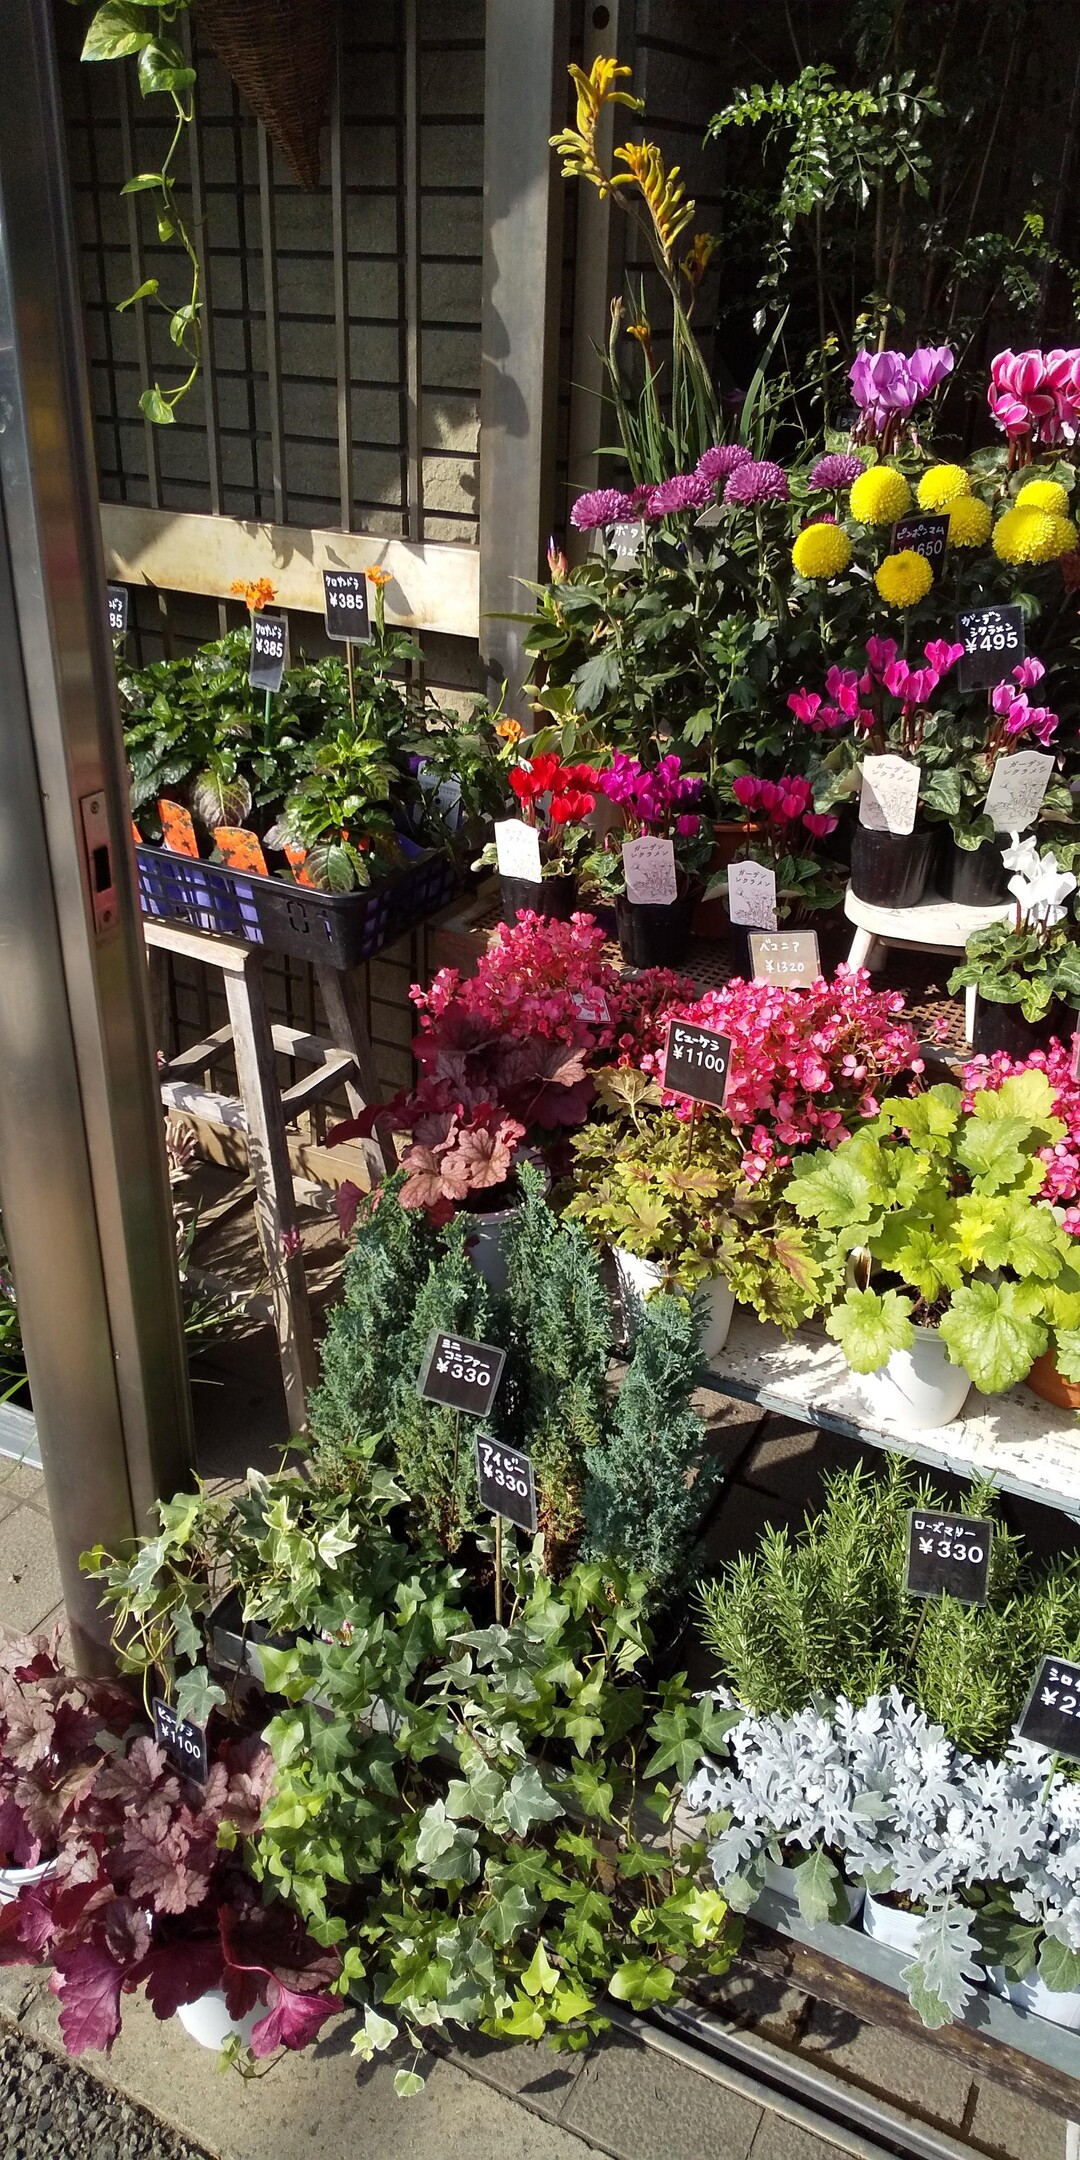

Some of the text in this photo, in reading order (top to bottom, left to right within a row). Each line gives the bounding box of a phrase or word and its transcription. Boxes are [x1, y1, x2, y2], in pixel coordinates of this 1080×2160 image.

[328, 591, 364, 610] ¥385
[960, 610, 1002, 628] ガーデン
[969, 622, 1014, 638] シクラメン
[255, 636, 283, 658] ¥385
[964, 631, 1019, 654] ¥495
[764, 959, 805, 974] ¥1320
[672, 1043, 725, 1073] ¥1100
[441, 1338, 462, 1351] ミニ
[443, 1349, 490, 1369] コニファー
[435, 1357, 491, 1387] ¥330
[478, 1442, 526, 1475] アイビー
[482, 1460, 529, 1497] ¥330
[914, 1520, 977, 1538] ローズマリー
[918, 1536, 984, 1564] ¥330
[160, 1722, 202, 1759] ¥1100
